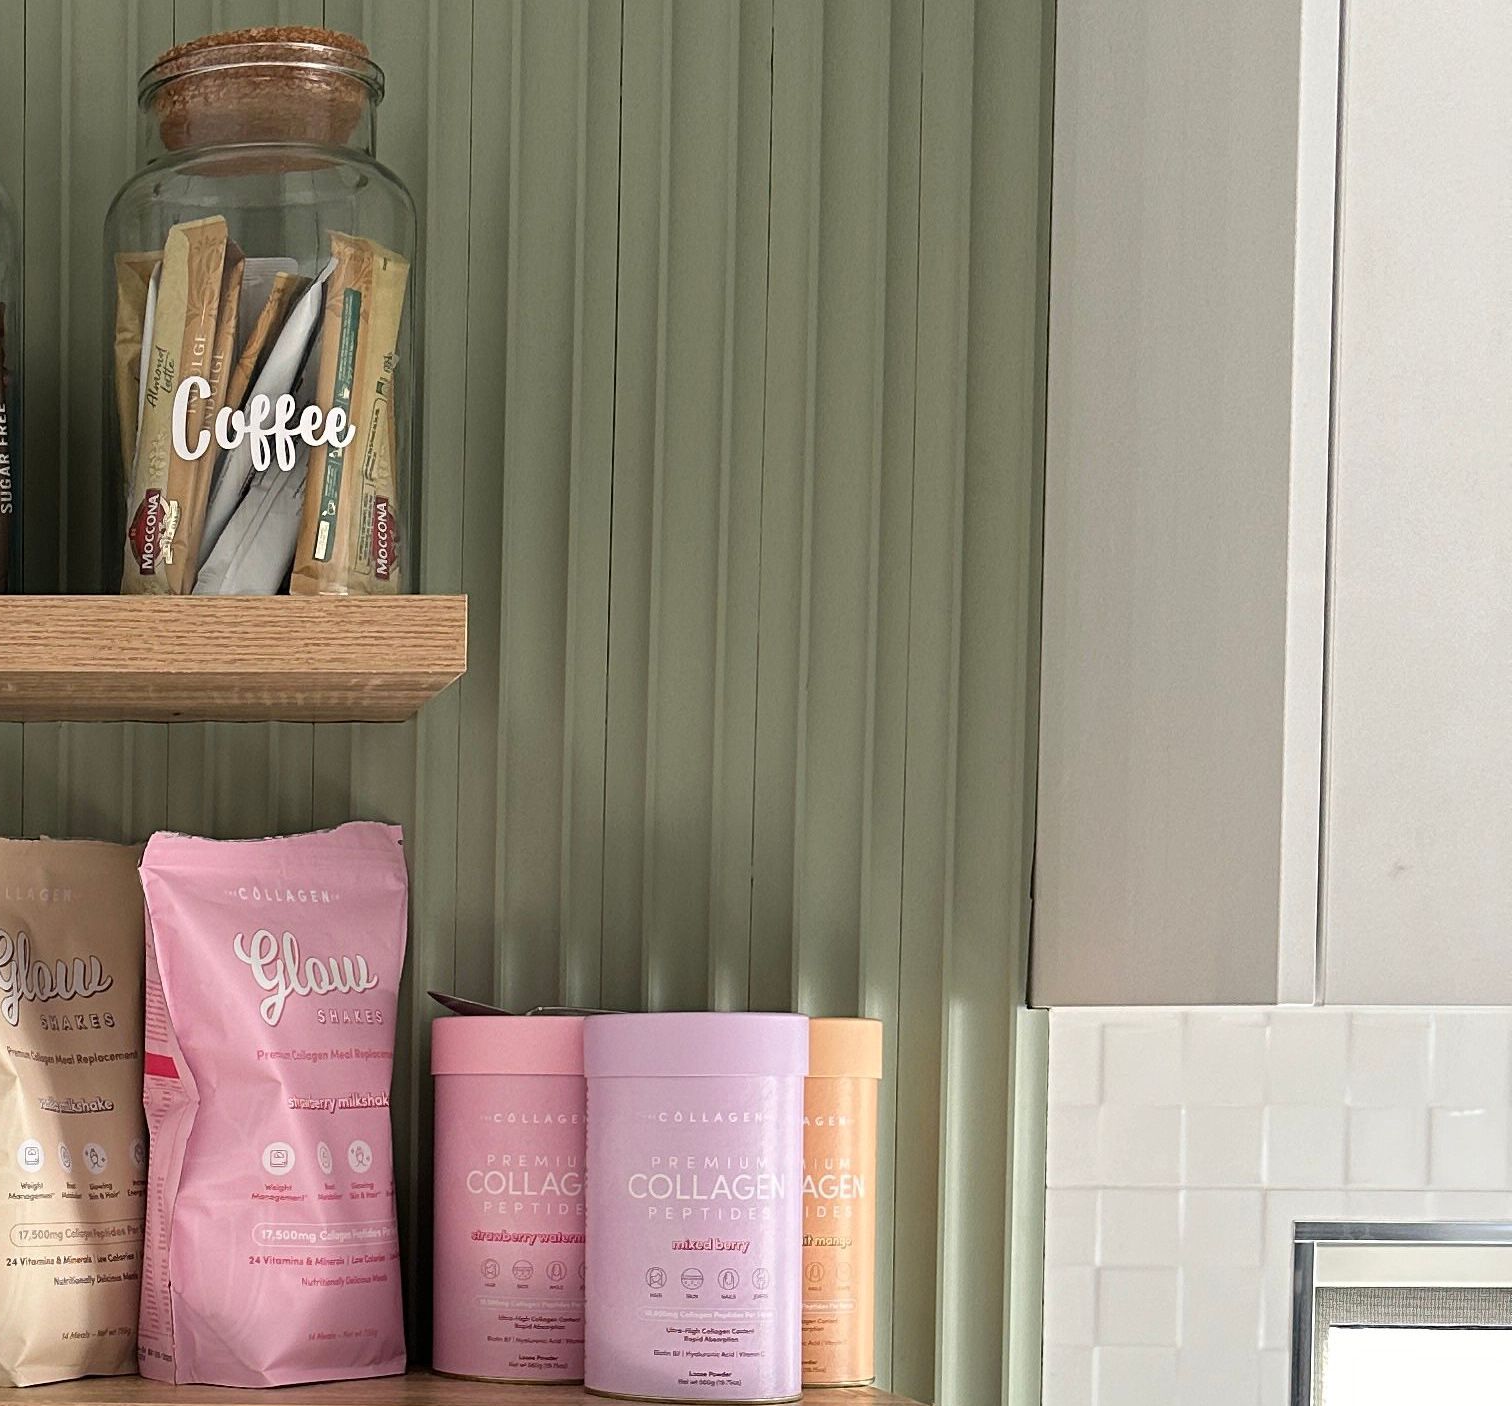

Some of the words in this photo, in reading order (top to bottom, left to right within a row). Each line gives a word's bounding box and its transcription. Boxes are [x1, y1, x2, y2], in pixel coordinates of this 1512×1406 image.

[147, 345, 169, 409] Almond
[161, 359, 175, 395] Latte
[172, 375, 356, 472] Coffee
[141, 493, 161, 571] MOCCONA
[375, 500, 388, 576] MOCCONA
[238, 886, 330, 904] COLLAGEN
[233, 929, 379, 1027] Glow
[40, 1012, 116, 1029] SHAKES
[317, 1008, 383, 1024] SHAKES
[77, 1050, 138, 1066] Replacement
[330, 1048, 353, 1059] Meal
[659, 1111, 763, 1123] COLLAGEN
[651, 1156, 769, 1170] PREMIUM
[628, 1173, 785, 1200] COLLAGEN
[648, 1206, 772, 1220] PEPTIDES
[18, 1229, 63, 1241] 17,500mg
[261, 1229, 317, 1243] 17,500mg
[471, 1229, 538, 1246] strawberry
[814, 1236, 853, 1250] mango
[671, 1238, 714, 1252] mixed
[714, 1238, 751, 1254] berry
[6, 1258, 18, 1267] 24
[249, 1256, 261, 1265] 24
[263, 1256, 304, 1266] Vitamins
